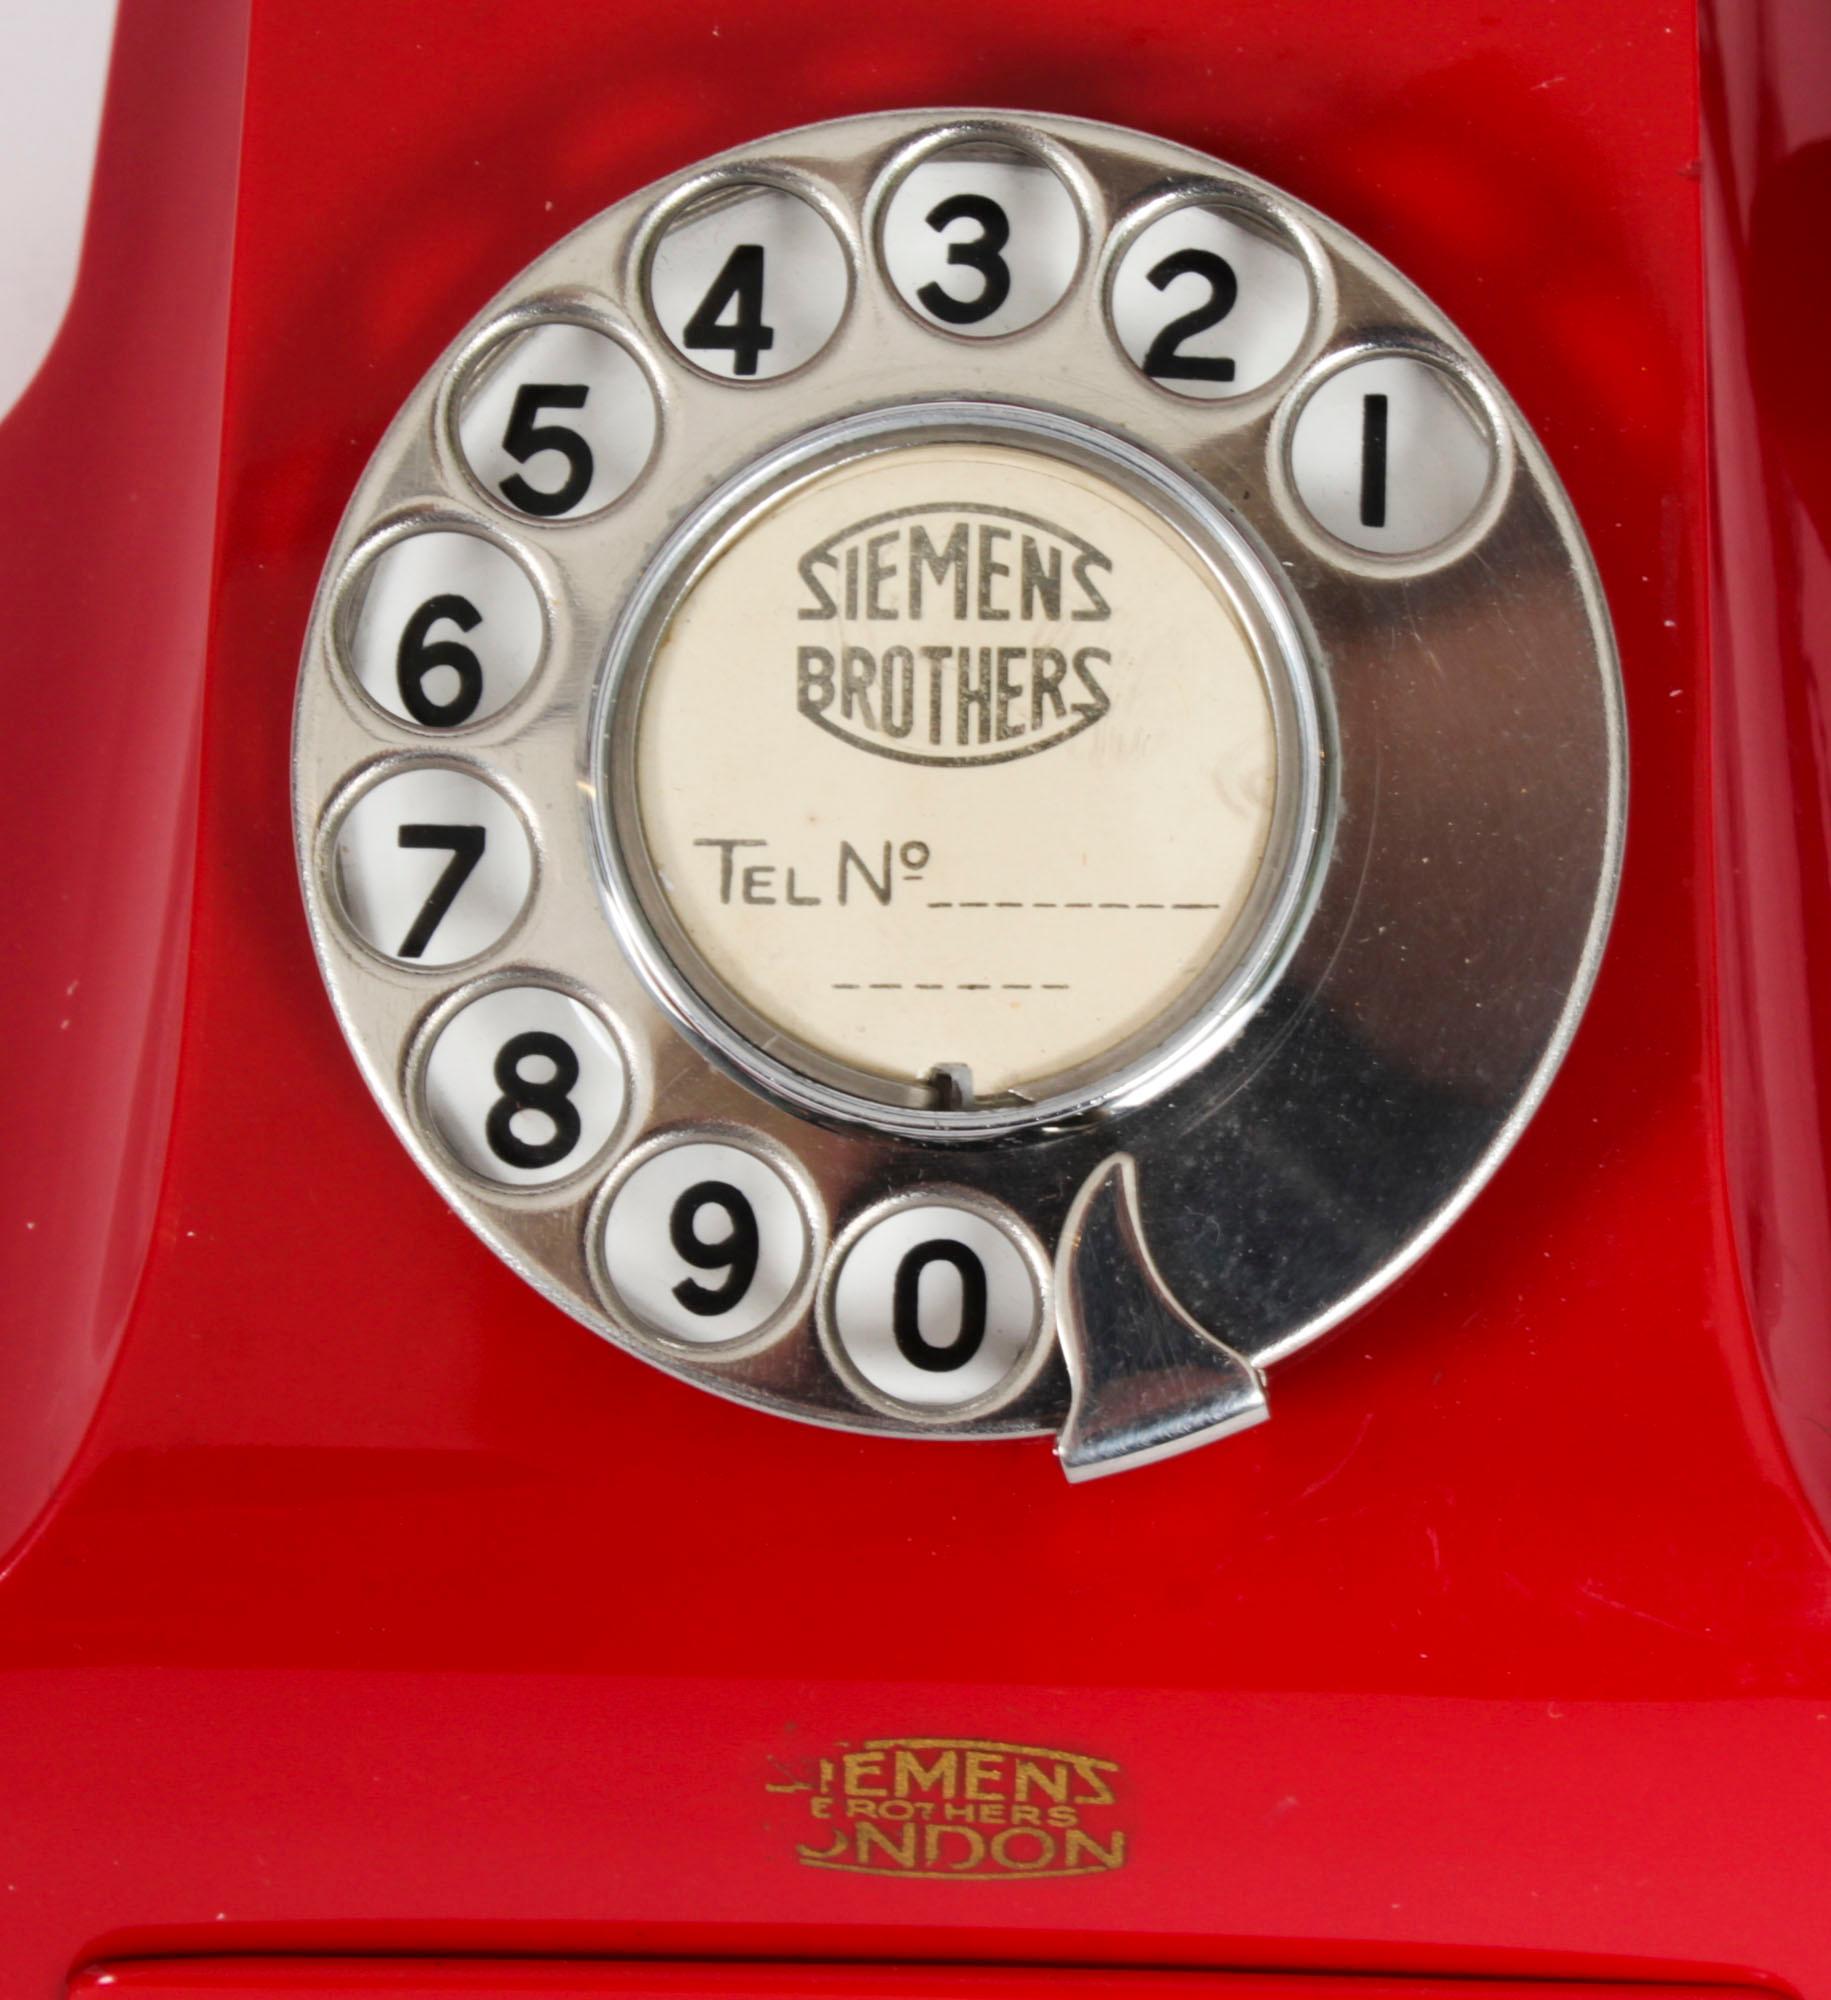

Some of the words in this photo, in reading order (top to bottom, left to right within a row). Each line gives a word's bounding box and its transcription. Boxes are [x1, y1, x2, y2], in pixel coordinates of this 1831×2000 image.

[683, 245, 774, 376] 4
[919, 195, 1011, 324] 3
[1137, 250, 1238, 383] 2
[498, 384, 594, 517] 5
[1360, 395, 1388, 527] 1
[797, 520, 1112, 621] SIEMENS
[397, 594, 483, 729] 6
[797, 646, 1112, 746] BROTHERS
[397, 825, 486, 957] 7
[487, 1032, 581, 1169] 8
[670, 1182, 760, 1315] 9
[894, 1240, 988, 1372] 0
